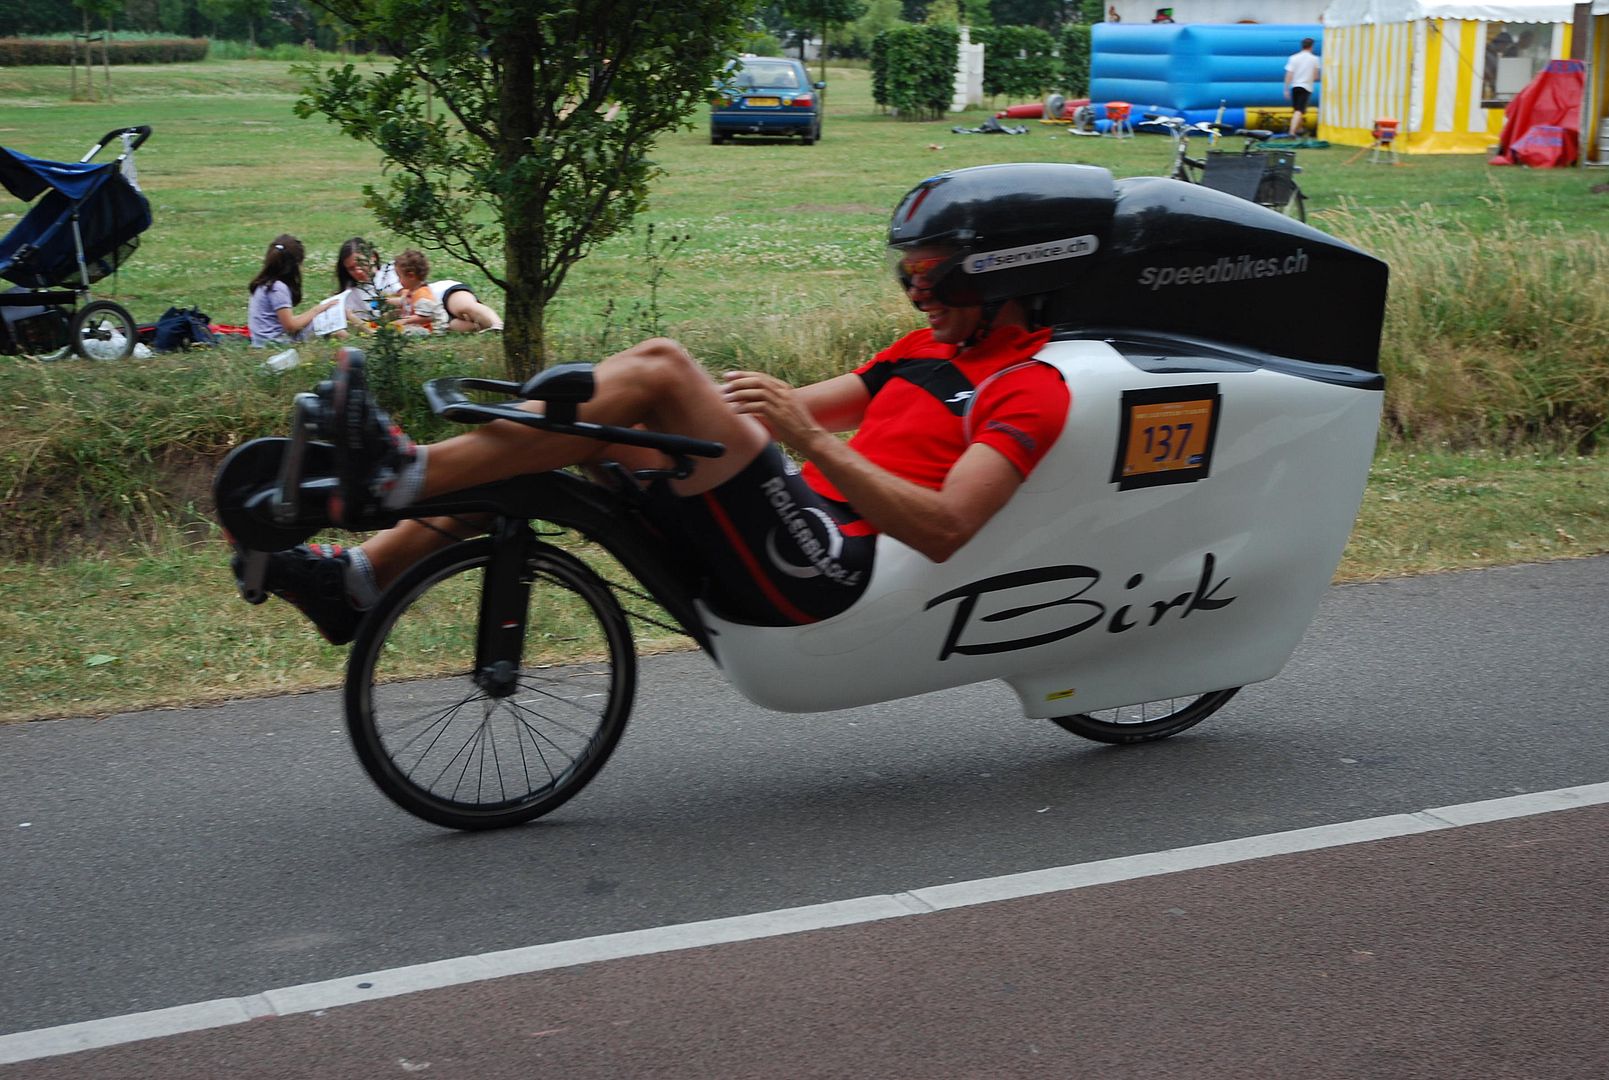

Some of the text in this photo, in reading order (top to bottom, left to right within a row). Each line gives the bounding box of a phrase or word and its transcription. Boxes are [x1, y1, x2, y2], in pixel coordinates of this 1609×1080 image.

[973, 239, 1090, 273] gfservice.ch
[1137, 247, 1309, 291] speedbikes.ch
[1142, 422, 1194, 463] 137
[922, 552, 1237, 661] Birk
